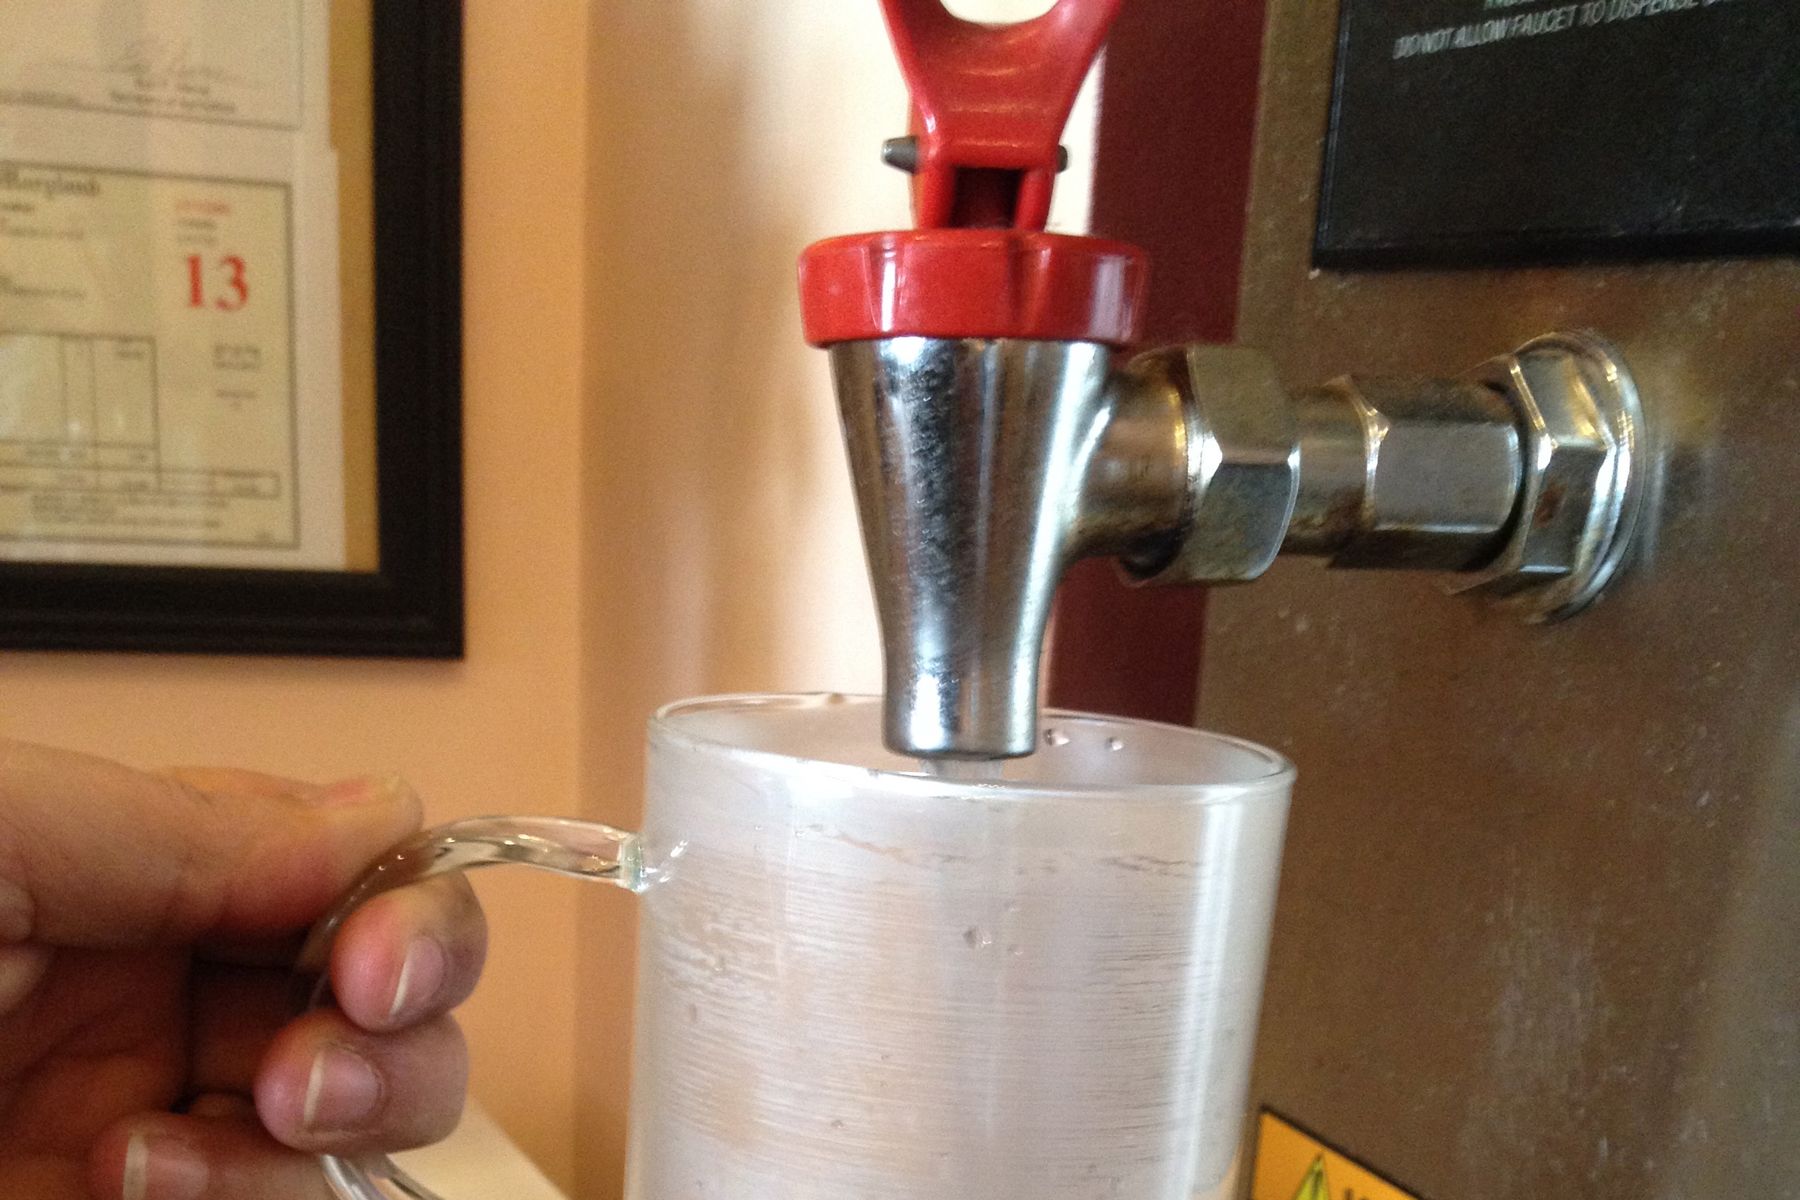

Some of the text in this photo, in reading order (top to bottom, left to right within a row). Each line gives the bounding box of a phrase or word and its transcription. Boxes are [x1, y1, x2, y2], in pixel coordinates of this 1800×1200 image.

[1453, 18, 1510, 49] ALLOW
[1506, 5, 1581, 39] FAUCET
[1577, 0, 1604, 27] TO
[186, 254, 249, 311] 13
